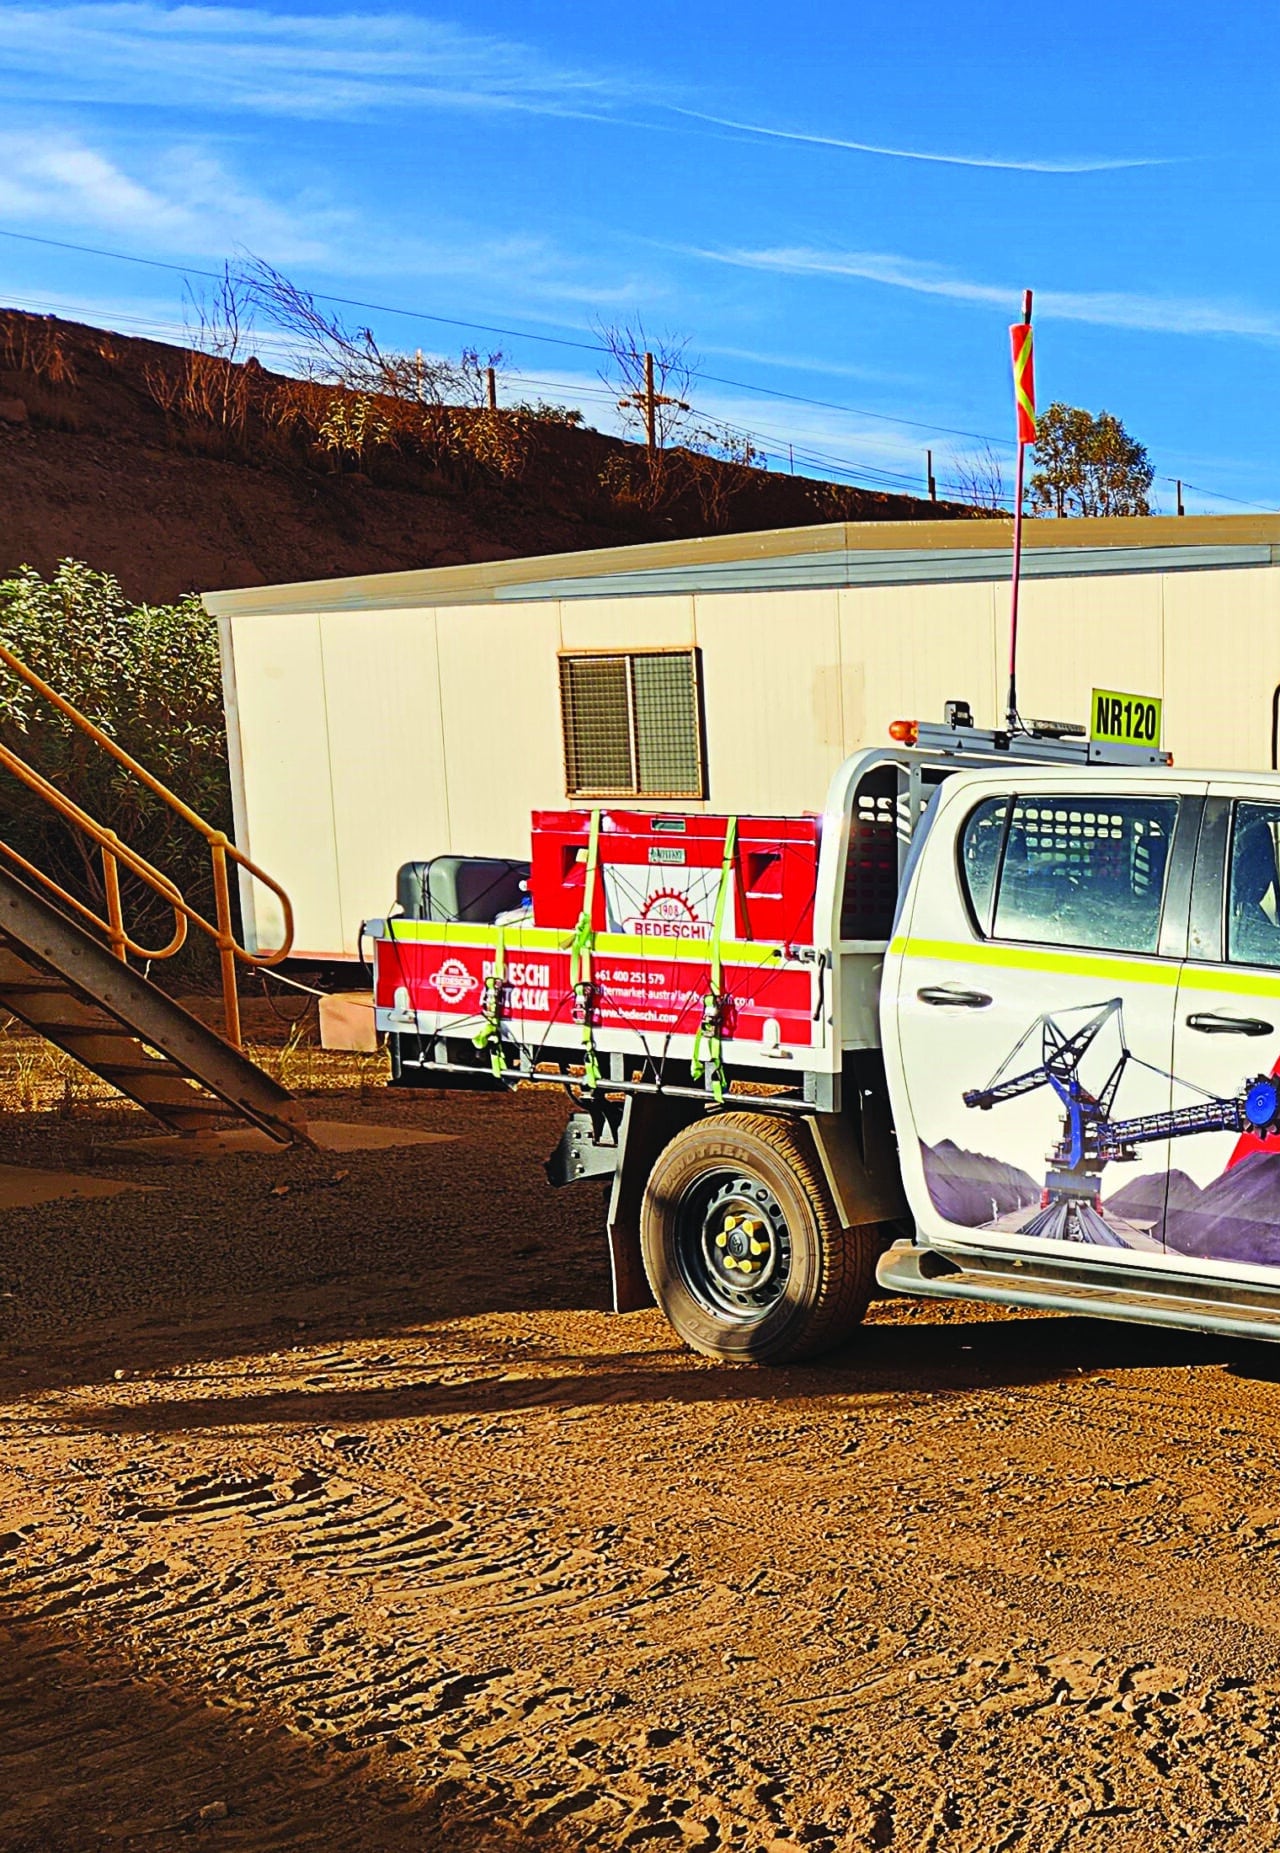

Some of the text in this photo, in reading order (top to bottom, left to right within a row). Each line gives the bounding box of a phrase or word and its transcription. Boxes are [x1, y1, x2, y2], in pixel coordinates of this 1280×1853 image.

[1096, 696, 1157, 741] NR120
[634, 922, 706, 940] BEDESCHI
[595, 970, 665, 985] +61 400 251 579
